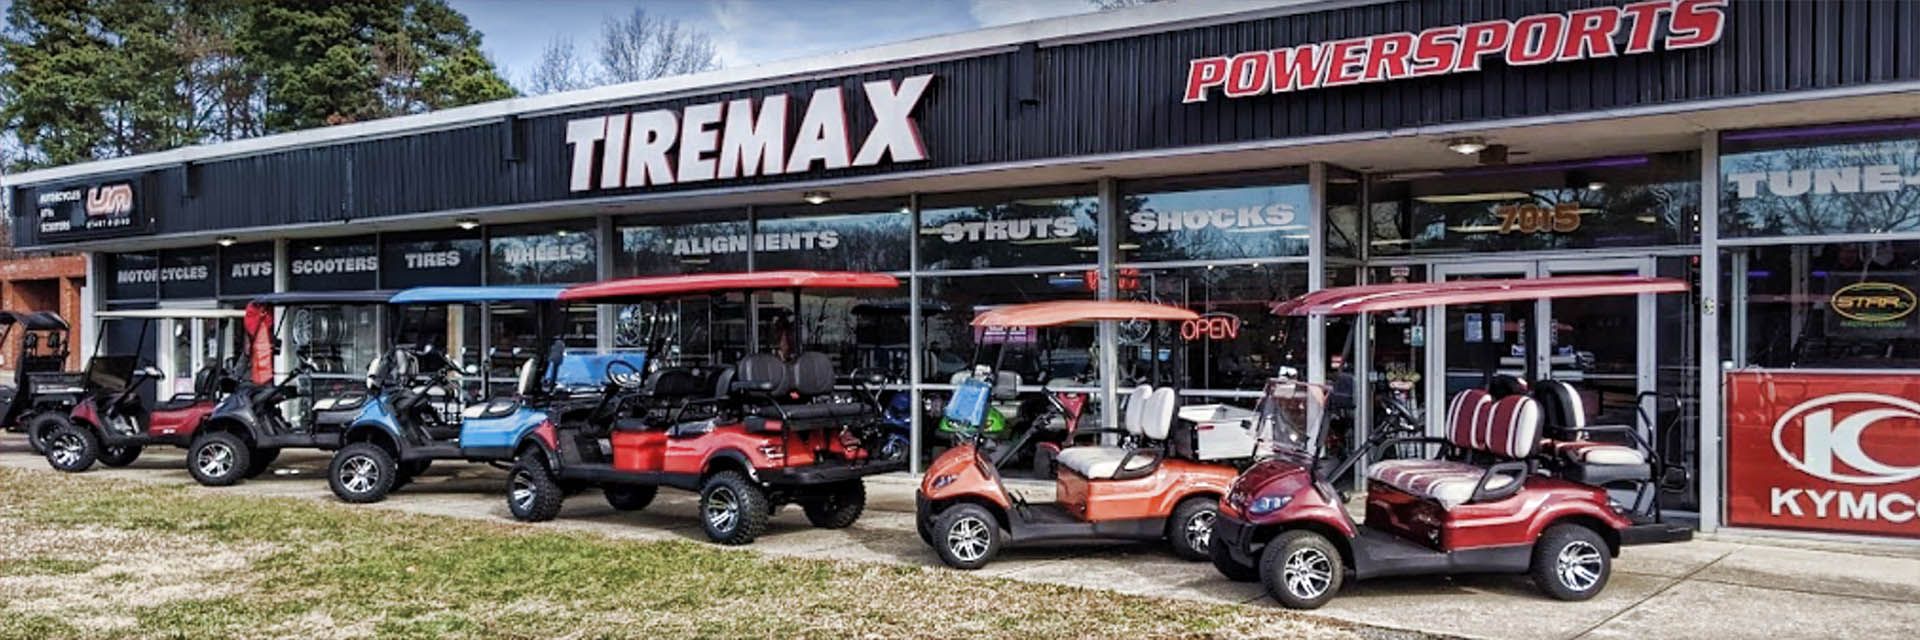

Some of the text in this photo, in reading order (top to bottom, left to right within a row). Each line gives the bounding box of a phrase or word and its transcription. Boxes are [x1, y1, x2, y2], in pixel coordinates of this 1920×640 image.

[1183, 0, 1728, 103] POWERSPORTS
[566, 74, 934, 192] TIREMAX
[941, 216, 1078, 243] STRUTS
[1129, 203, 1294, 233] SHOCKS
[1495, 203, 1581, 234] 7015
[292, 256, 378, 274] SCOOTERS
[405, 250, 461, 268] TIRES
[505, 245, 587, 263] WHEELS
[1181, 317, 1237, 340] OPEN
[1771, 486, 1920, 523] KYMC
